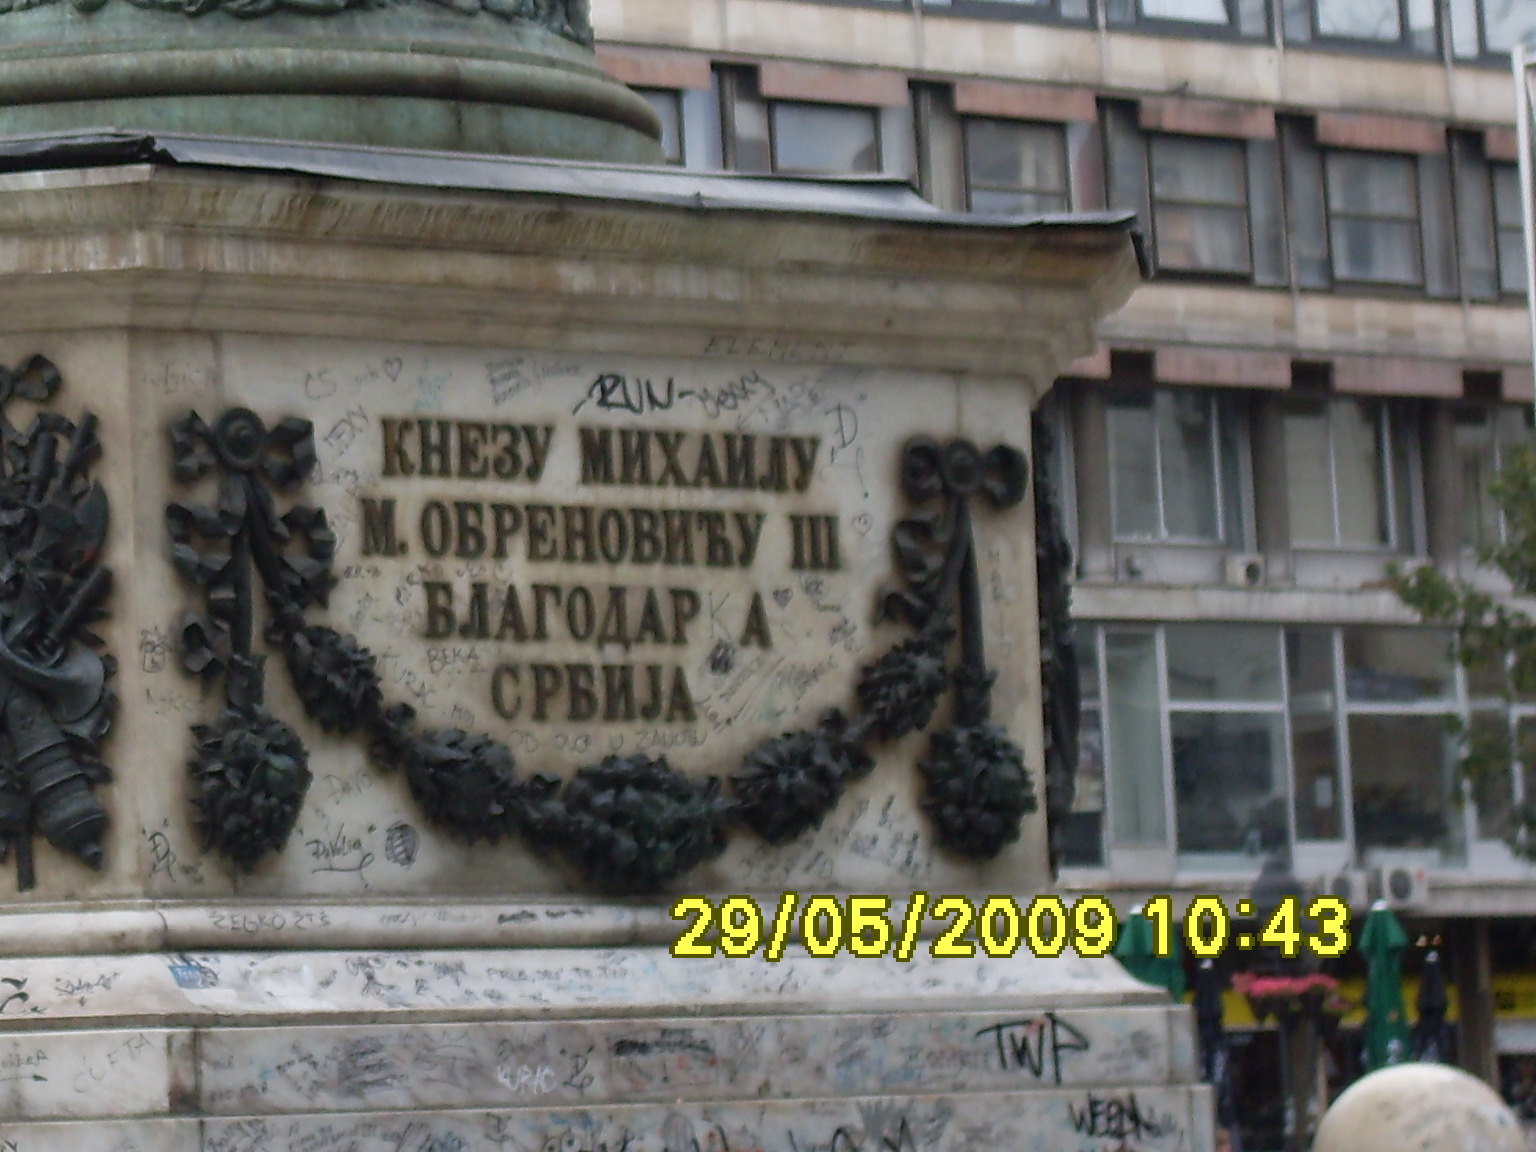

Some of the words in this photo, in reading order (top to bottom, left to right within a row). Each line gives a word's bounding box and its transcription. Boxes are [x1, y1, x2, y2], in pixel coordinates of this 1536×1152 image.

[380, 418, 556, 483] КНЕЗУ
[579, 427, 821, 493] МИХАИЛУ
[420, 501, 767, 569] ОБРЕНОВИЋУ
[491, 664, 698, 723] СРБИЈА
